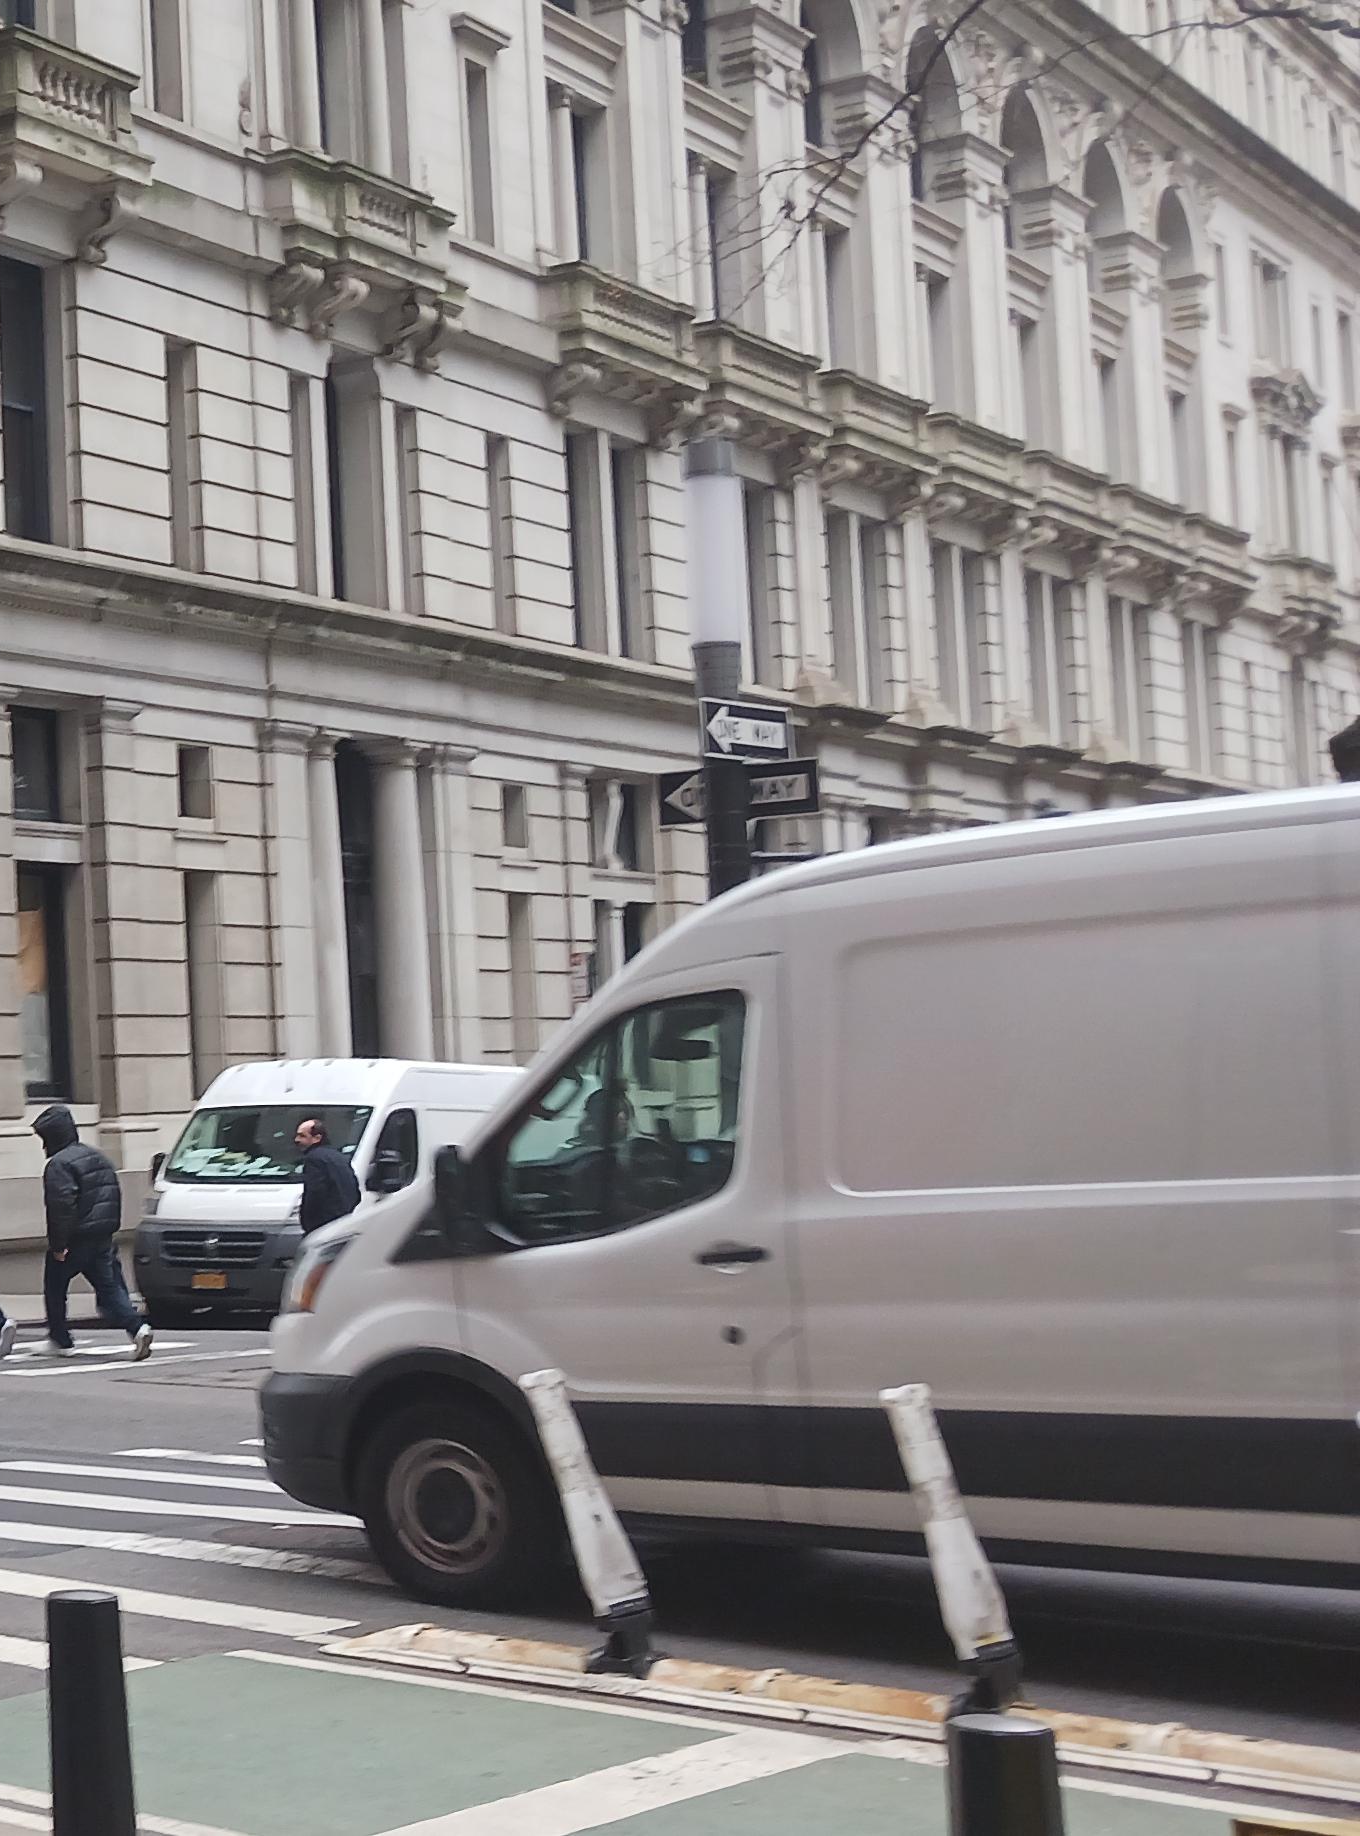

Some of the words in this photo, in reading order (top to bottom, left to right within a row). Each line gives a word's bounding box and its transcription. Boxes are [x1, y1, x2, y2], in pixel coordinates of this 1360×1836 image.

[717, 719, 742, 741] ONE
[752, 723, 780, 742] WAY
[751, 776, 799, 802] WAY
